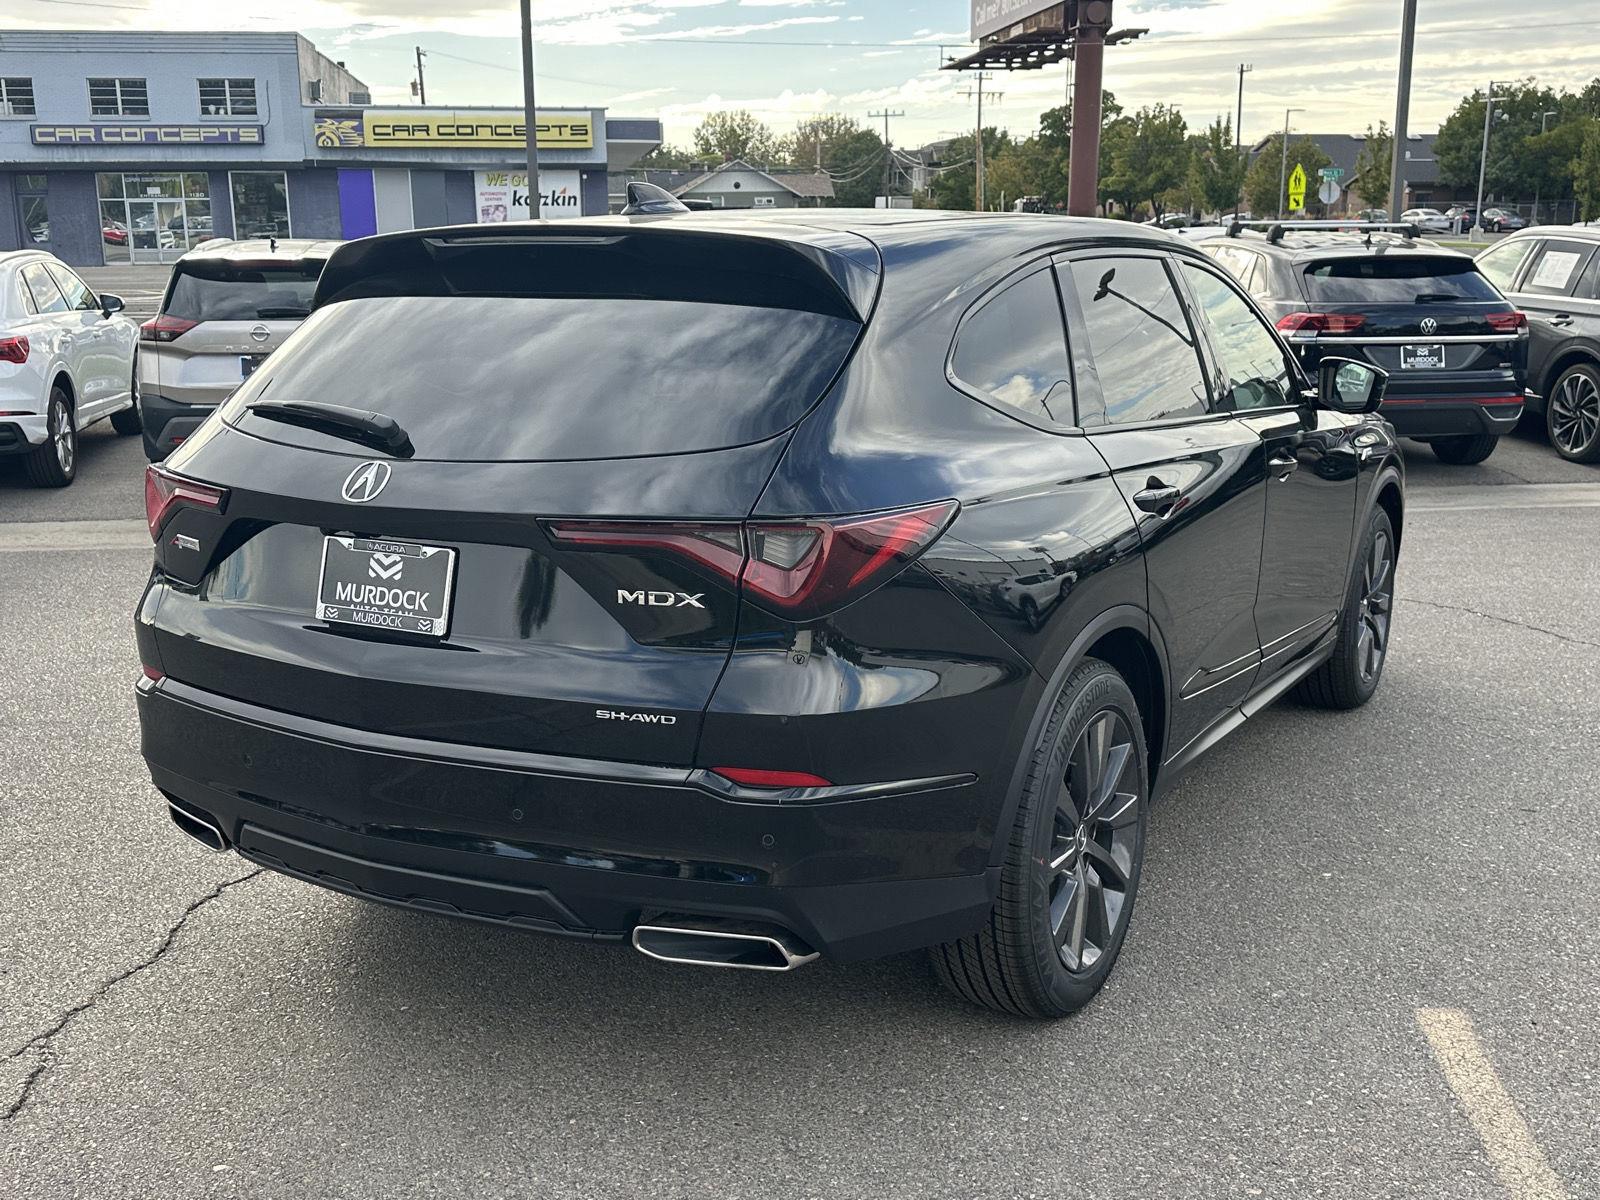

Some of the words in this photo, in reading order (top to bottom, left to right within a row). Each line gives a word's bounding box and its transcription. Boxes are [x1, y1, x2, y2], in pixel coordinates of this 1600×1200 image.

[35, 127, 96, 142] CAR
[101, 127, 259, 142] CONCEPTS
[372, 124, 430, 137] CAR
[436, 124, 589, 137] CONCEPTS
[487, 173, 508, 187] WE
[511, 174, 541, 187] GO
[373, 543, 406, 554] ACURA
[335, 581, 430, 612] MURDOCK
[617, 589, 706, 609] MDX
[352, 611, 403, 628] MURDOCK
[595, 709, 677, 725] SH-AWD
